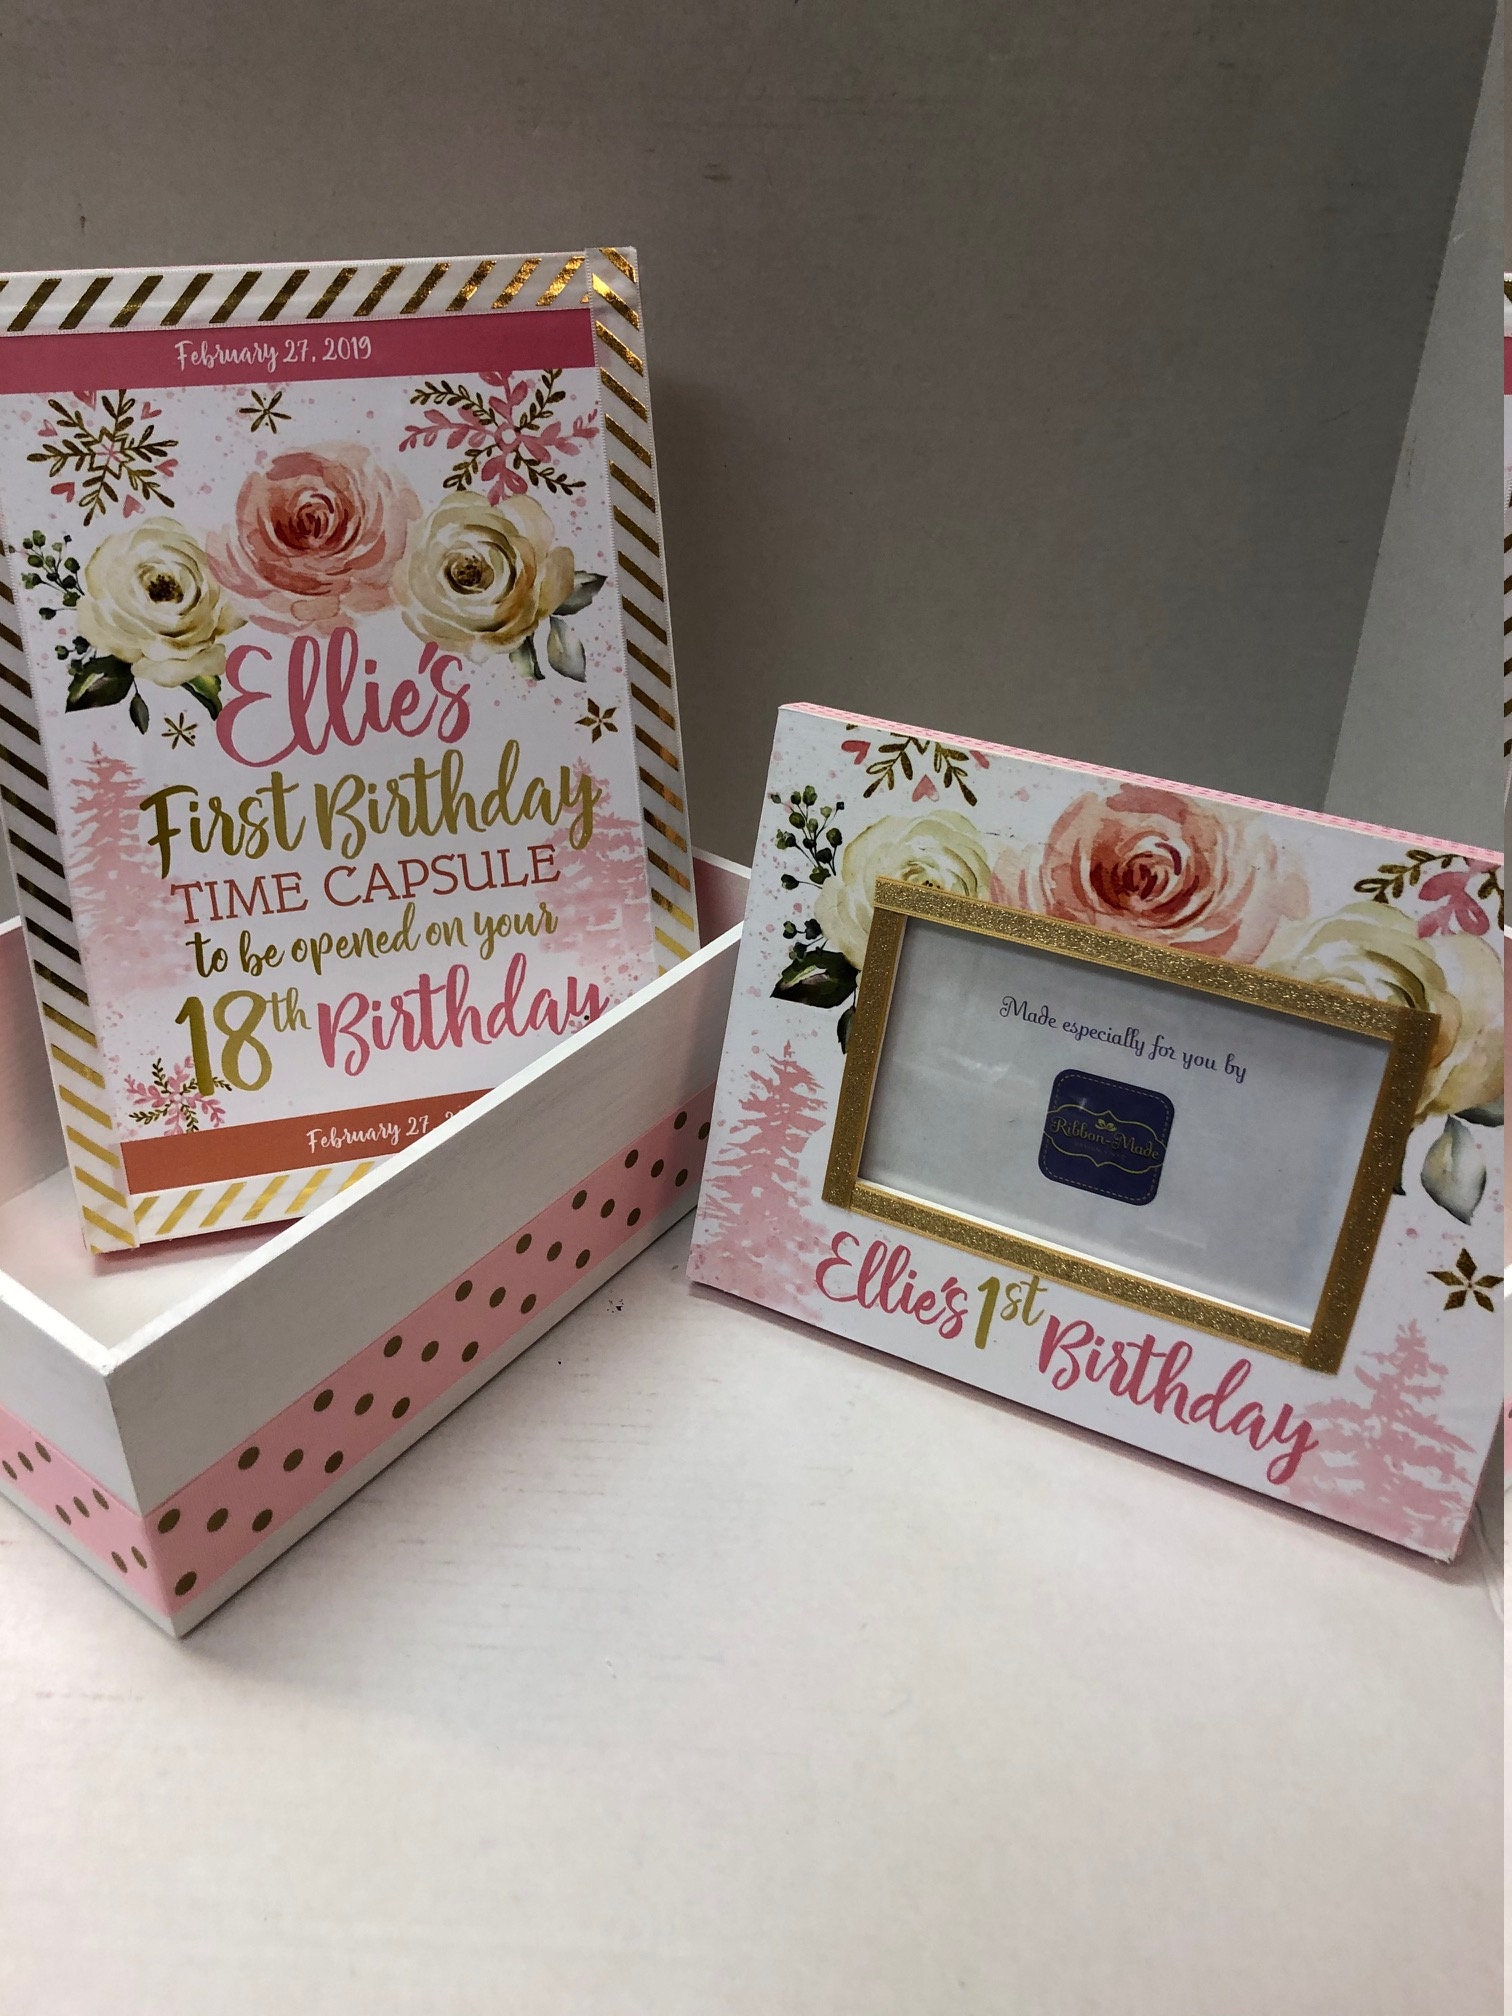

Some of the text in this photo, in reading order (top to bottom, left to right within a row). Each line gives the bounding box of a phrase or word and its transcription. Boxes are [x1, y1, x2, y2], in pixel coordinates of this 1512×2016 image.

[174, 335, 372, 373] February 27, 2019
[216, 627, 471, 767] Ellie's
[140, 740, 602, 879] First Birthday
[170, 844, 561, 925] TIME CAPSULE
[186, 902, 558, 978] to be opened on your
[175, 953, 610, 1096] 18th Birthday
[1000, 996, 1248, 1084] Made especially for you by
[306, 1114, 437, 1153] February 27
[815, 1231, 1320, 1485] Ellie's 1st Birthday
